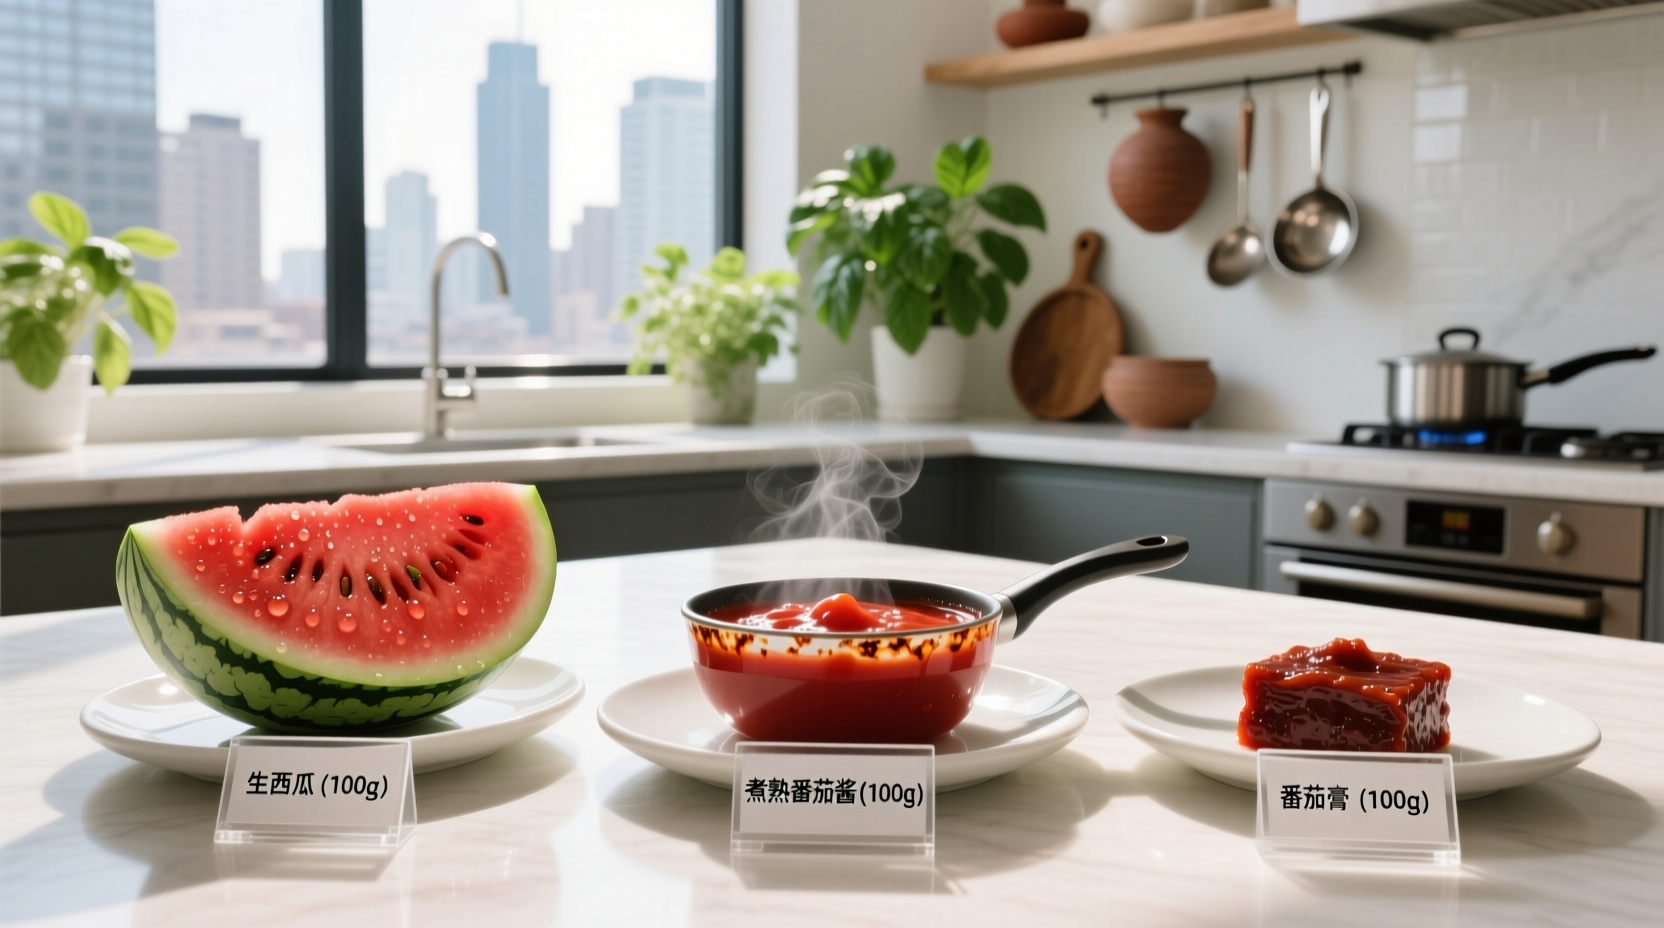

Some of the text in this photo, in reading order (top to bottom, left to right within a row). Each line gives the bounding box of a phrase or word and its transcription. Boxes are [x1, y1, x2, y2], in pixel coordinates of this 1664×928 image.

[245, 770, 388, 802] 生西瓜 (100g)
[1280, 783, 1429, 816] 番茄膏 (100g)
